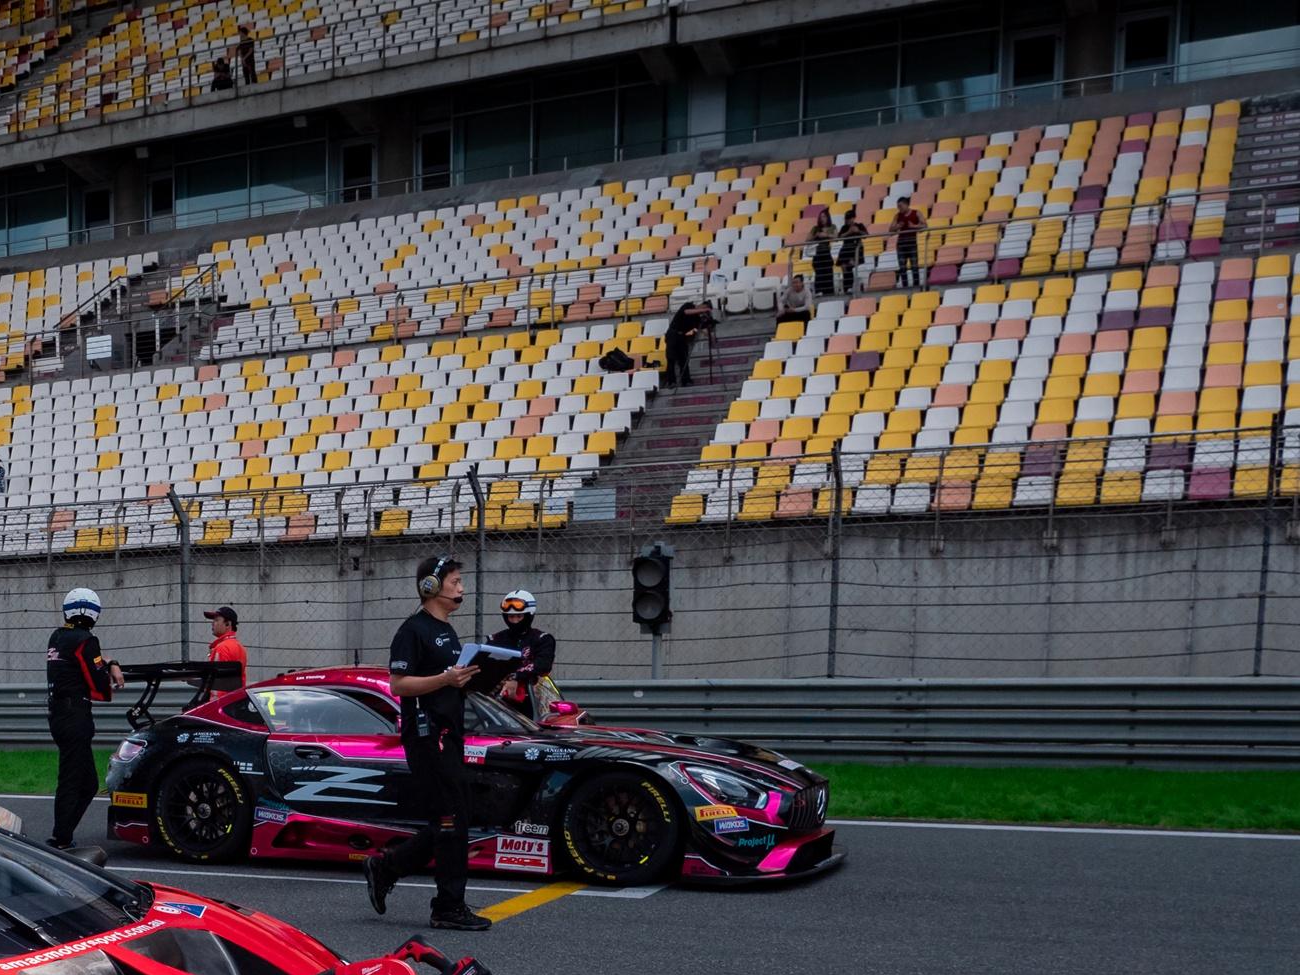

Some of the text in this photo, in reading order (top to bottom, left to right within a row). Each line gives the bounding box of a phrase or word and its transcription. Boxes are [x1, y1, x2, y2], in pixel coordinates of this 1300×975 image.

[700, 806, 736, 818] PIRELLI
[515, 820, 549, 835] freem
[500, 838, 544, 853] Moty's
